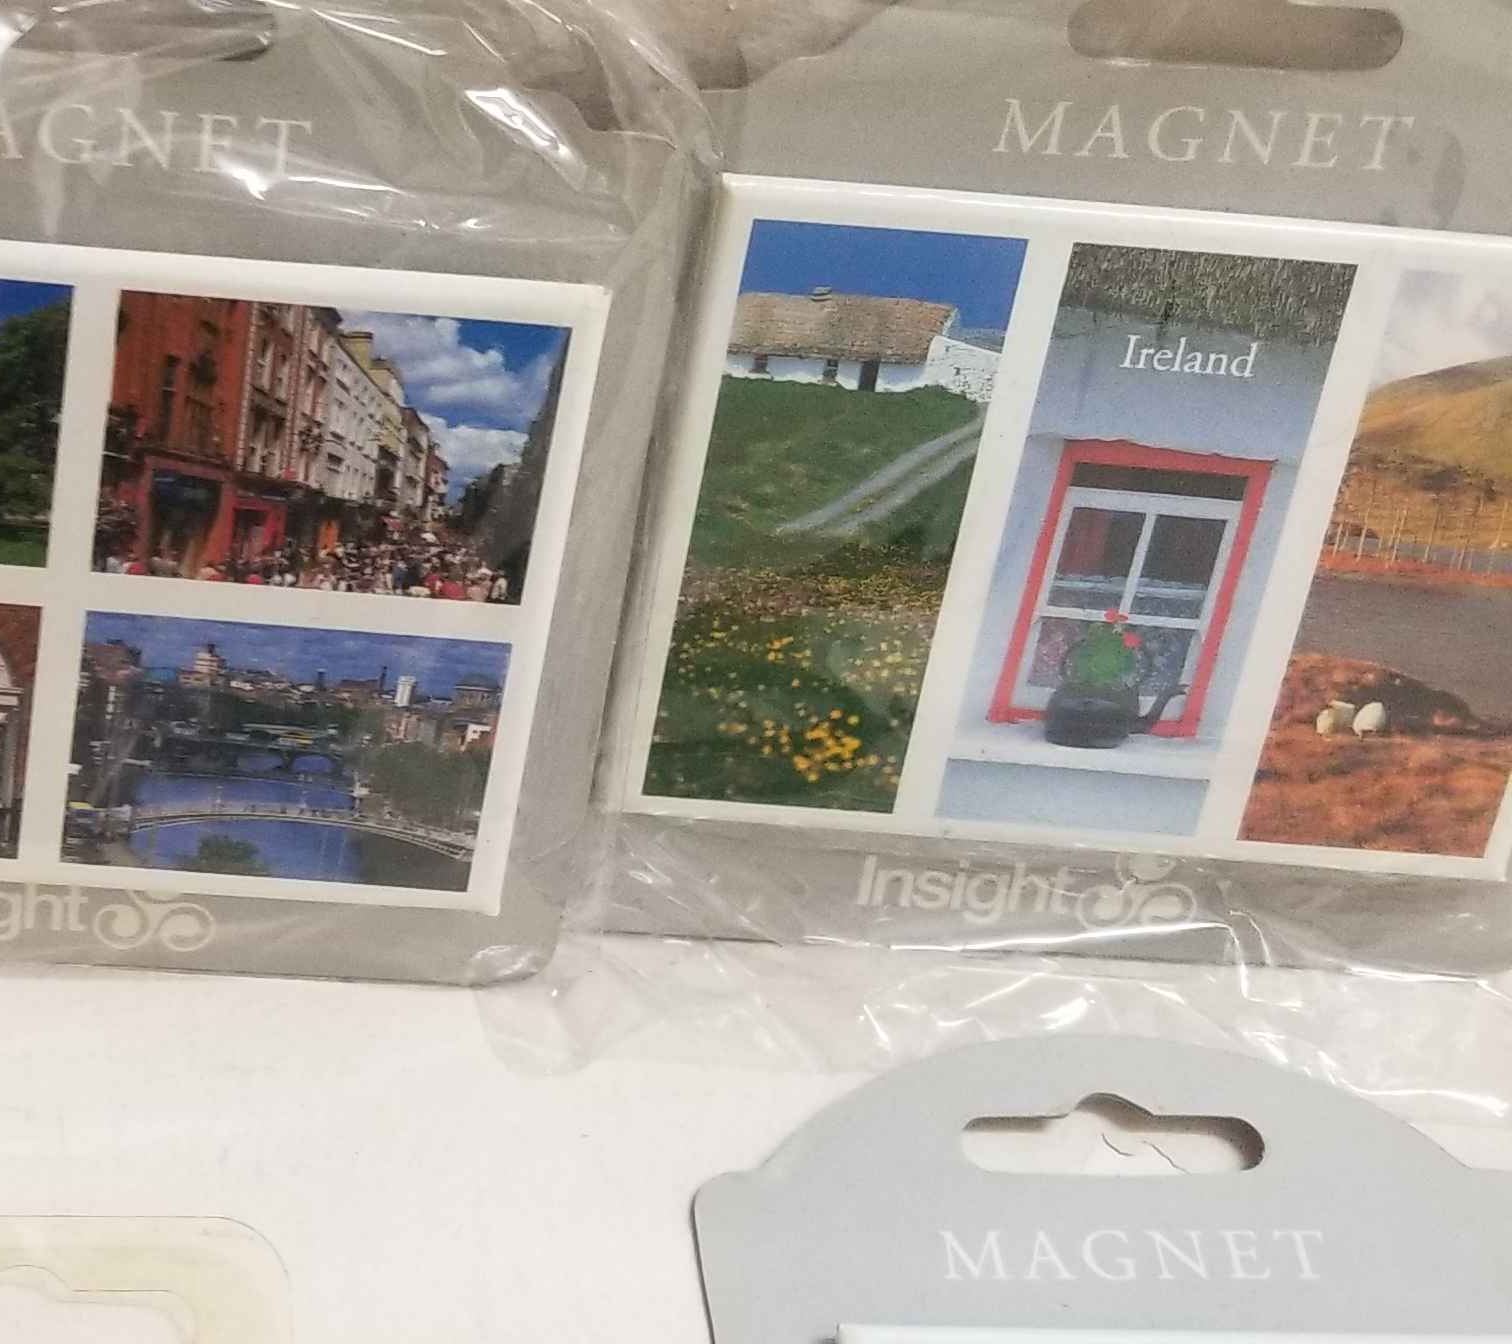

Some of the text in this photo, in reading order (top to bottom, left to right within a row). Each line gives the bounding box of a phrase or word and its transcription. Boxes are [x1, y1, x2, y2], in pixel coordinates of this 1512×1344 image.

[991, 98, 1416, 170] MAGNET
[1119, 334, 1258, 378] Ireland
[856, 854, 1076, 925] Insight
[937, 1228, 1324, 1282] MAGNET
